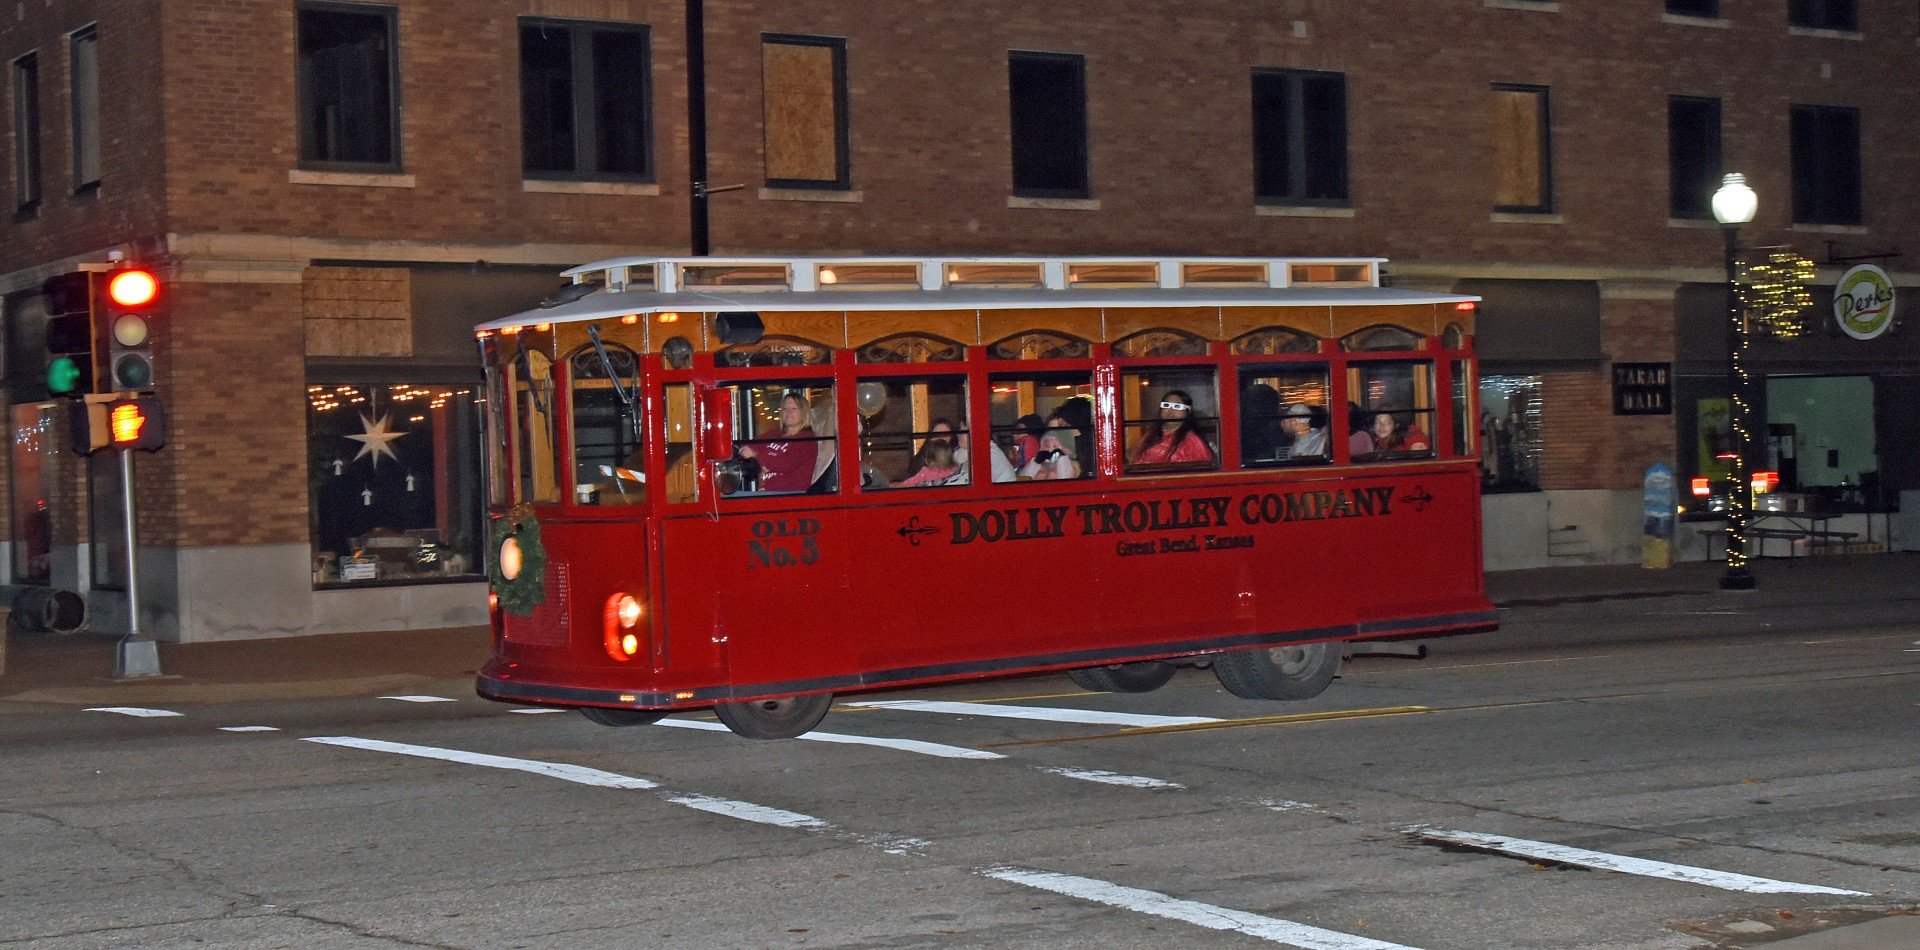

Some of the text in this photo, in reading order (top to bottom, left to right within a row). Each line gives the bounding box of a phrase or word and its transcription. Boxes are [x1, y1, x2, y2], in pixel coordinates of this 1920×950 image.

[1833, 282, 1893, 322] Perks
[752, 518, 821, 538] OLD
[949, 486, 1395, 544] DOLLY TROLLEY COMPANY
[747, 537, 820, 570] No. 5
[1116, 534, 1255, 556] Great Bend, Kansas
